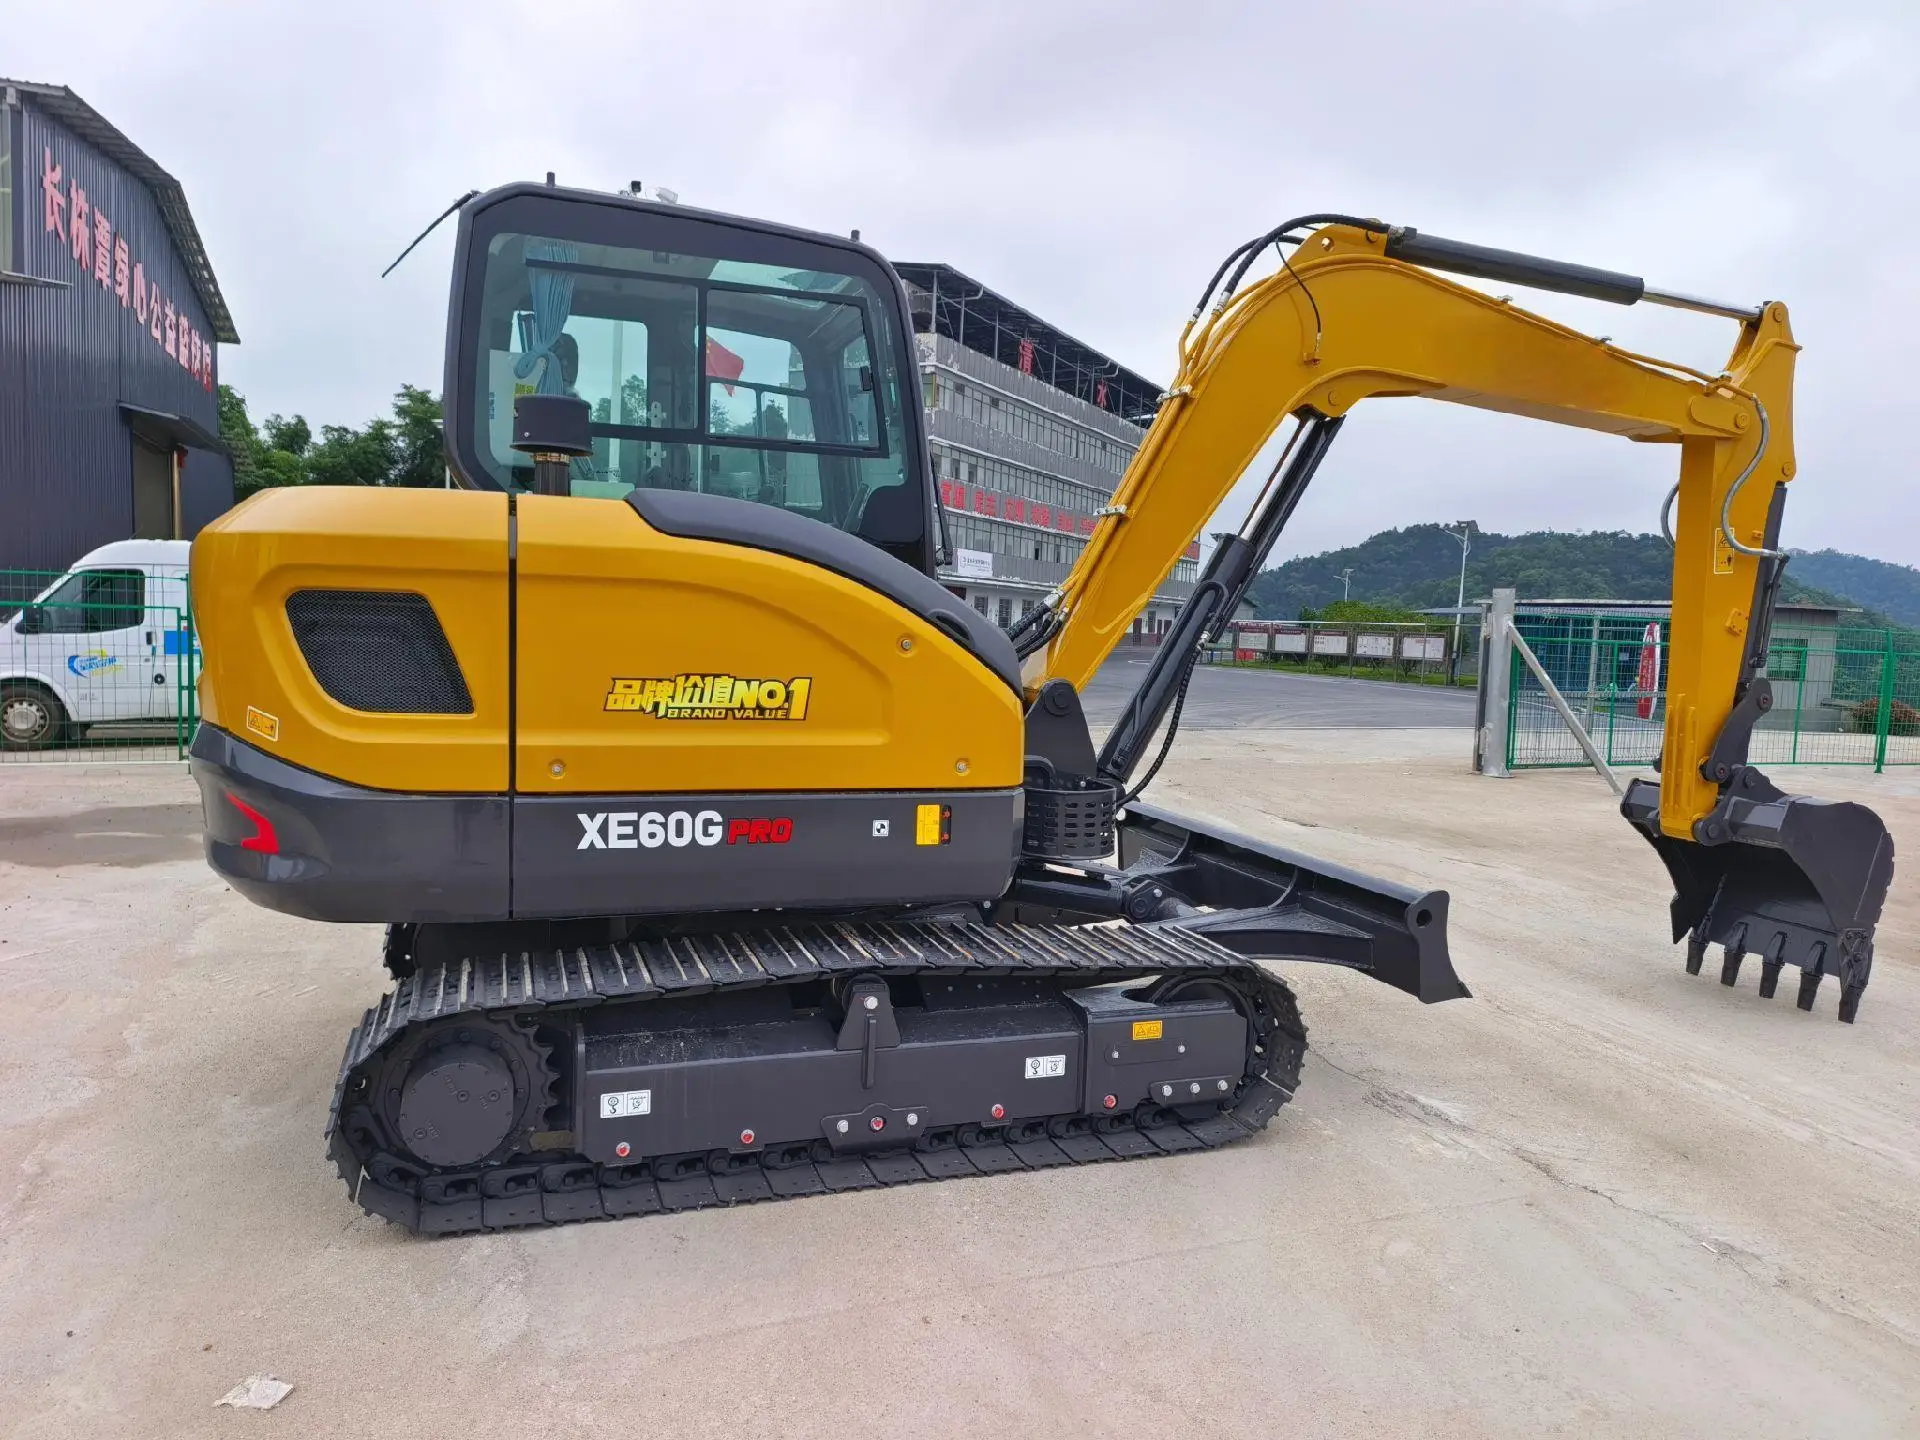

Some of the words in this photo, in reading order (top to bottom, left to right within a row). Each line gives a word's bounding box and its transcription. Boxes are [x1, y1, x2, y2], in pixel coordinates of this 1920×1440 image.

[667, 708, 725, 719] BRAND
[734, 708, 788, 719] VALUE
[577, 810, 723, 850] XE60G
[727, 817, 793, 845] PRO
